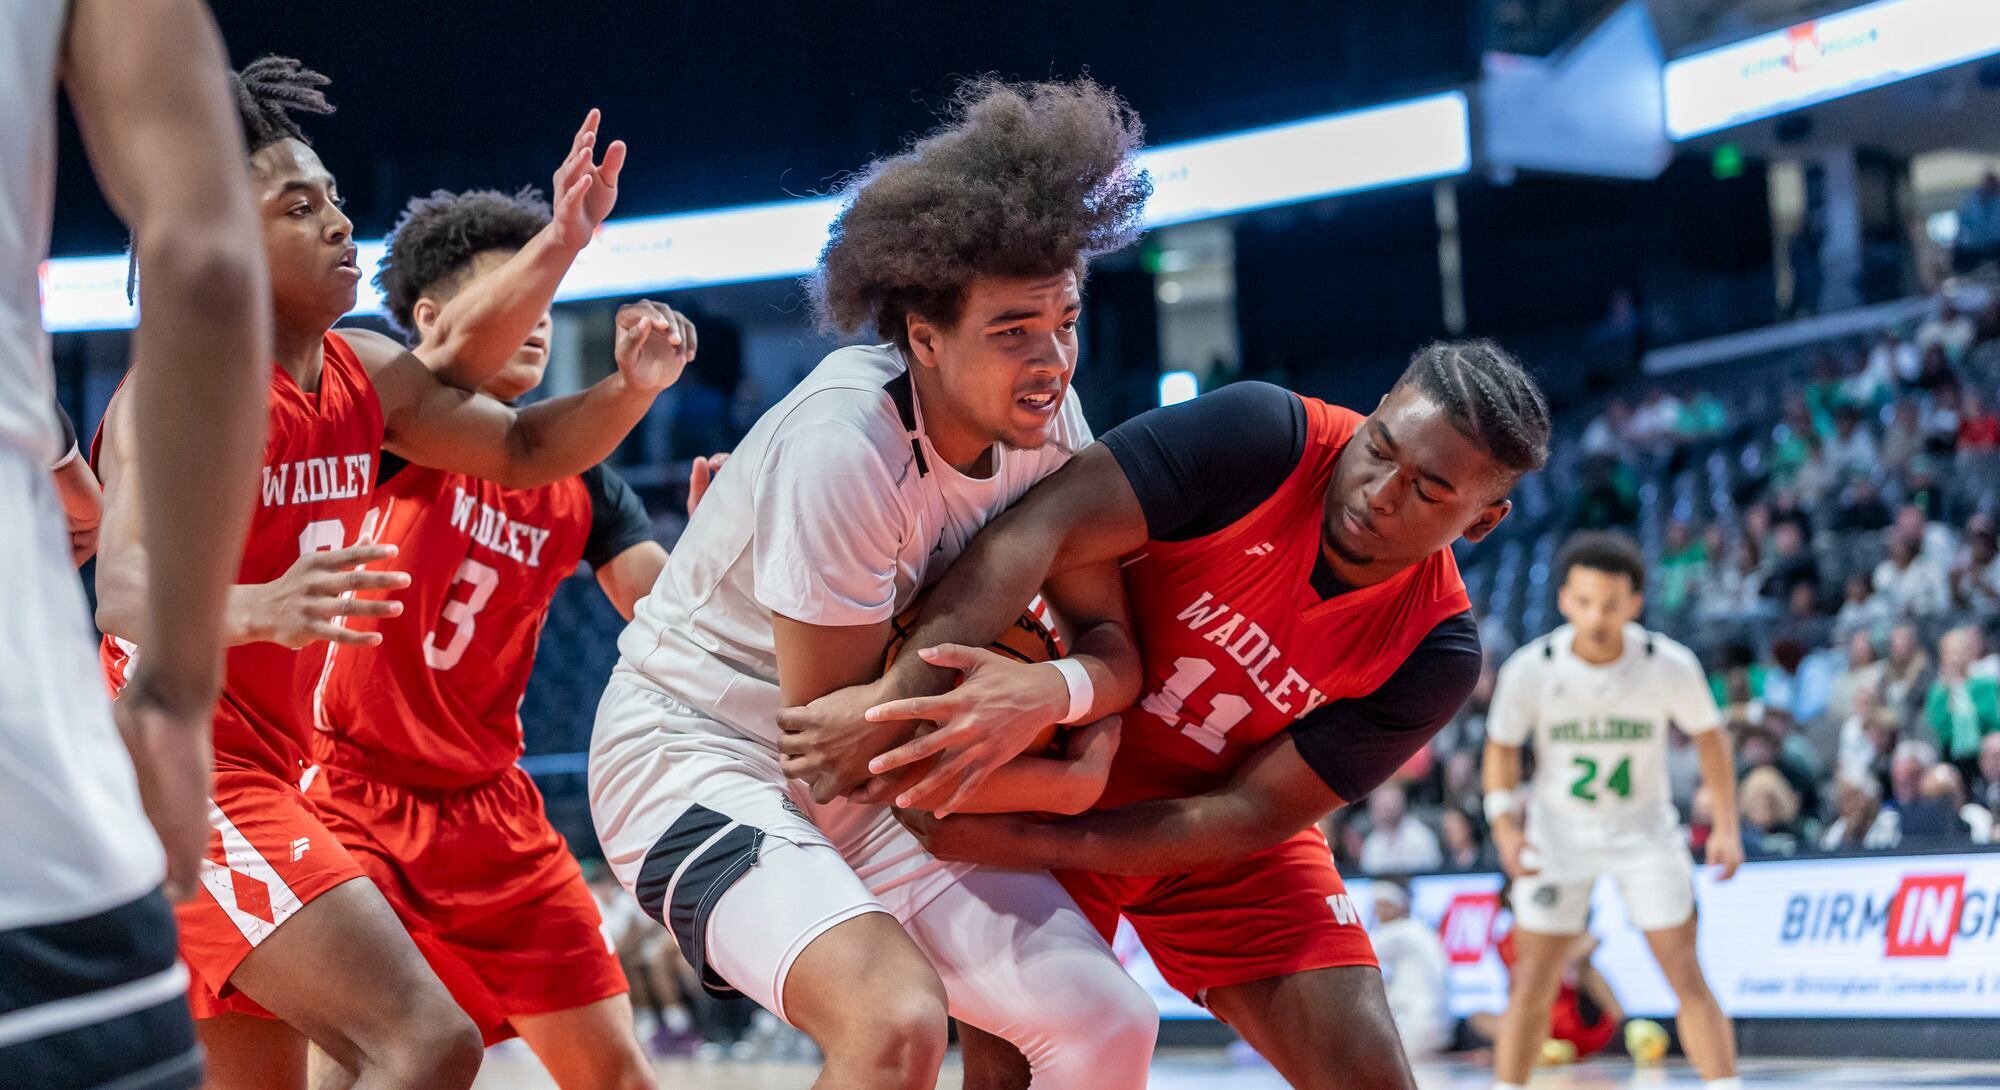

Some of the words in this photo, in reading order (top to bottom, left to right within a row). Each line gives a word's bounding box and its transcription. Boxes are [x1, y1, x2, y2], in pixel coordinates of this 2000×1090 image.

[262, 453, 372, 507] WADLEY
[422, 558, 499, 671] 3
[1176, 591, 1327, 720] WADLEY
[1141, 656, 1253, 755] 11
[1569, 755, 1633, 803] 24
